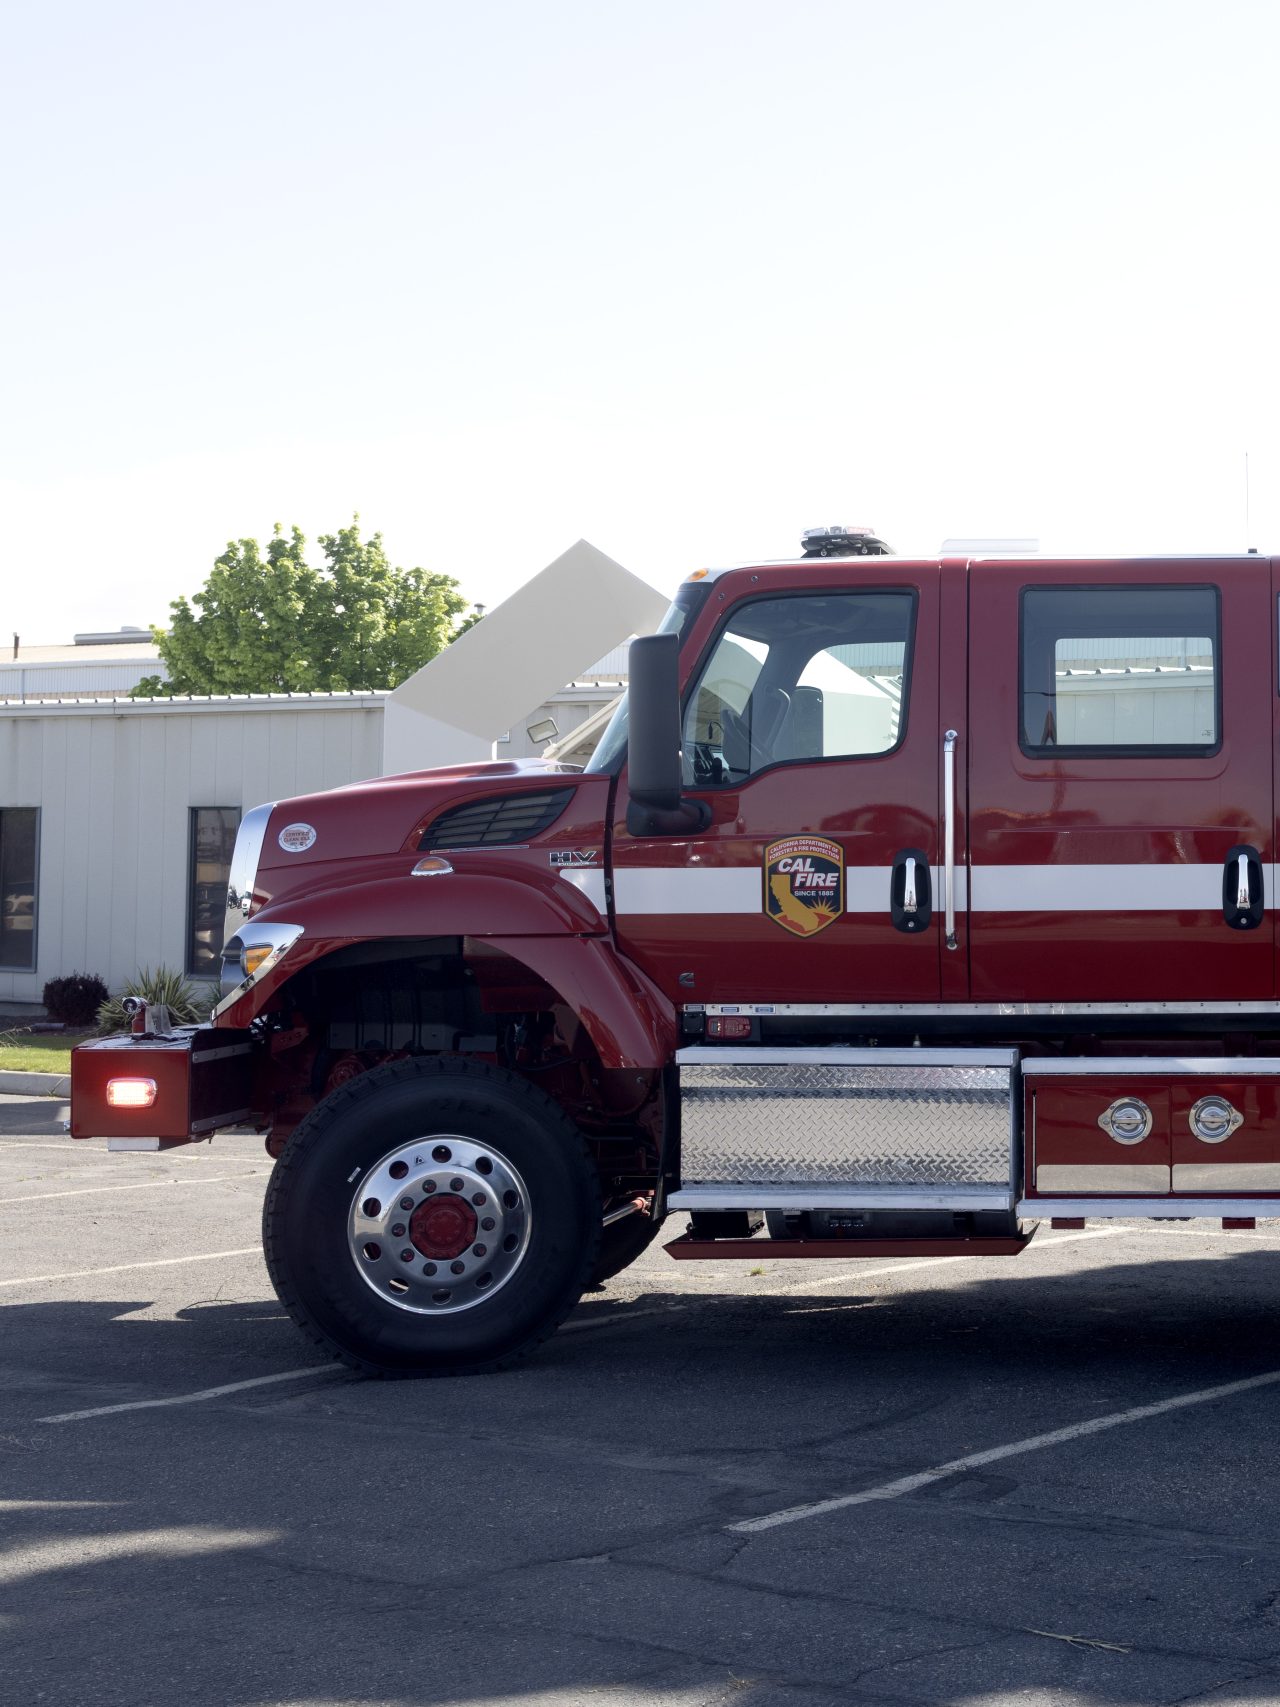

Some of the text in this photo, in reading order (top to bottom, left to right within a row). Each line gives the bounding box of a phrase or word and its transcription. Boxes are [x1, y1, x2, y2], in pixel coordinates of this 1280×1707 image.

[769, 847, 794, 861] FORESTRY
[809, 846, 840, 861] PROTECTION
[770, 840, 799, 854] CALIFORNIA
[799, 840, 831, 849] DEPARTMENT
[550, 851, 597, 862] HV
[778, 858, 815, 872] CAL
[795, 873, 839, 886] FIRE
